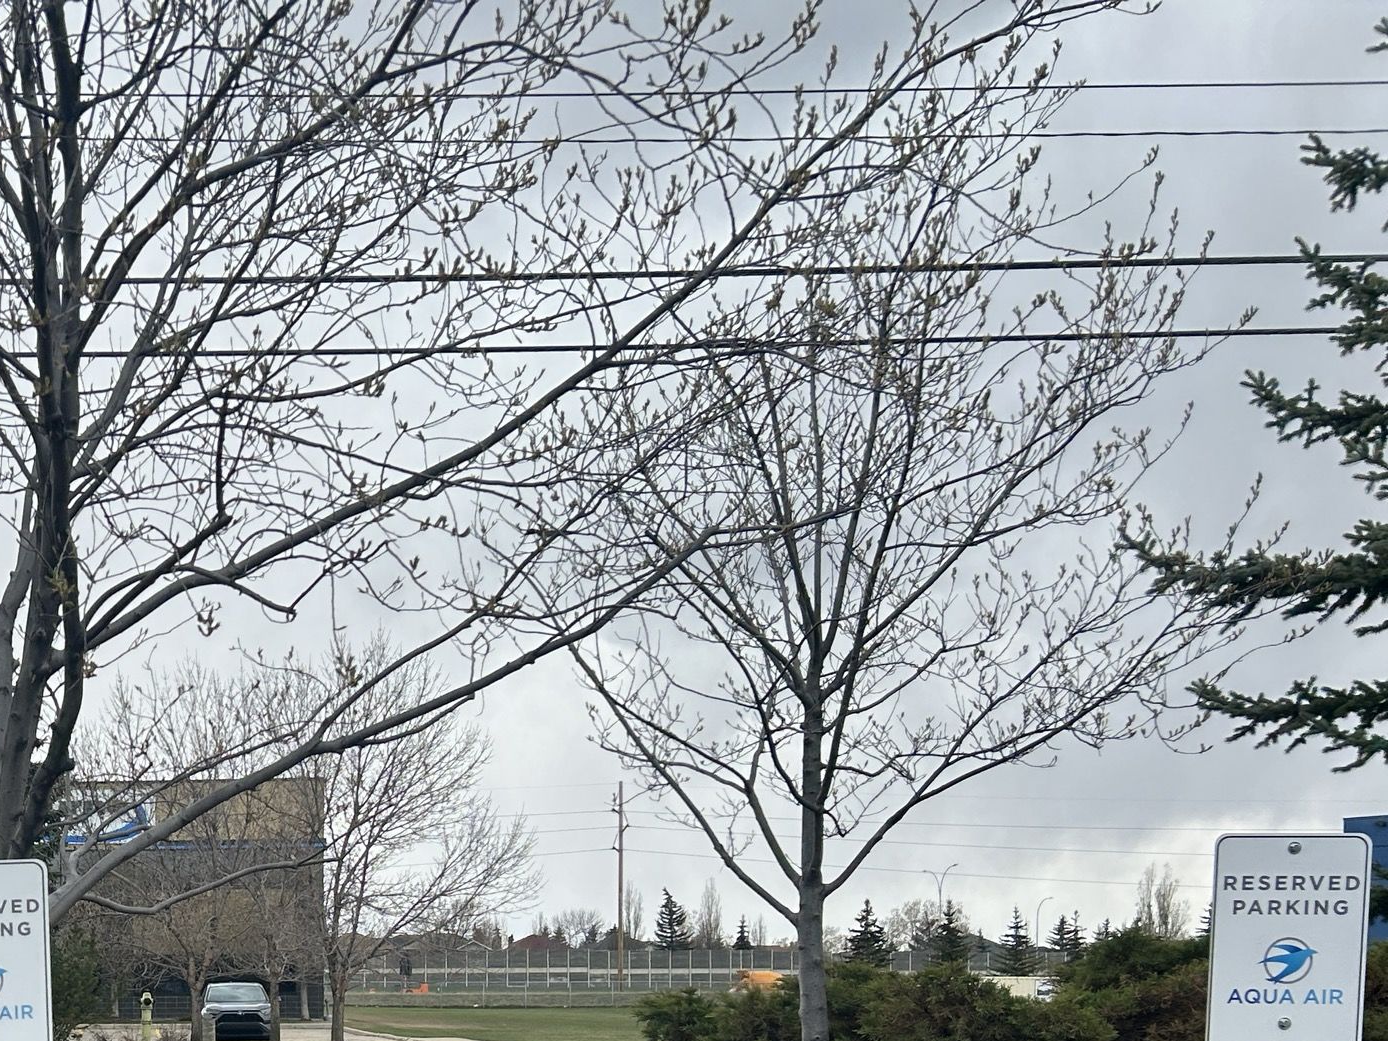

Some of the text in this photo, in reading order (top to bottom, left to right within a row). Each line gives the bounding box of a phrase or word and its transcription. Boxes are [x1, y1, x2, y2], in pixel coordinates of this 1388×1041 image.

[1223, 875, 1361, 891] RESERVED
[1232, 900, 1350, 915] PARKING
[1227, 988, 1344, 1005] AQUA AIR
[0, 1004, 34, 1020] AIR
